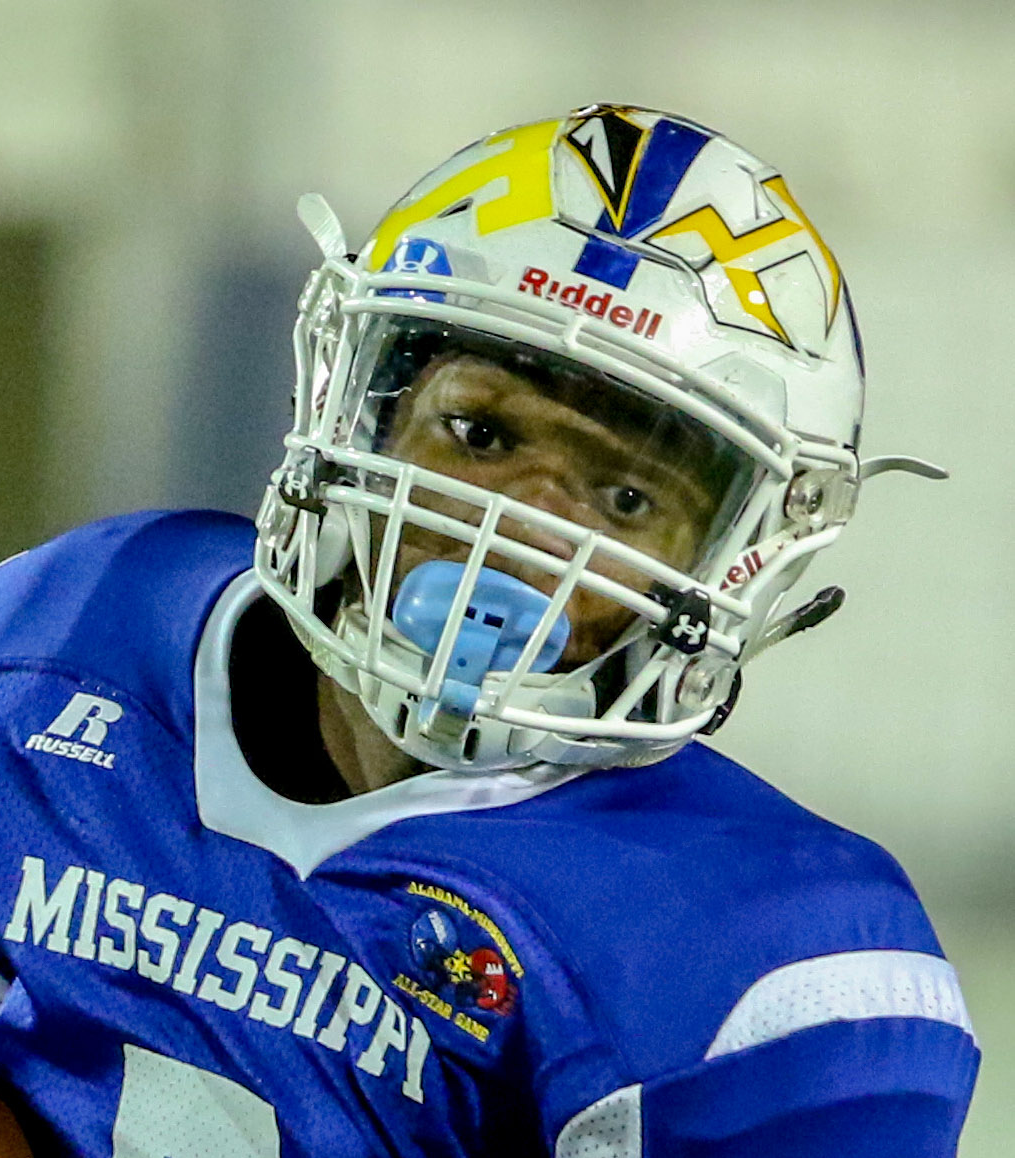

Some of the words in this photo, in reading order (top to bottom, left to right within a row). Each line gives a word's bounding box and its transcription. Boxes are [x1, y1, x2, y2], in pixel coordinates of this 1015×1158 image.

[517, 266, 663, 340] Riddell
[25, 733, 116, 770] RUSSELL
[3, 856, 425, 1104] MISSISSIPPI
